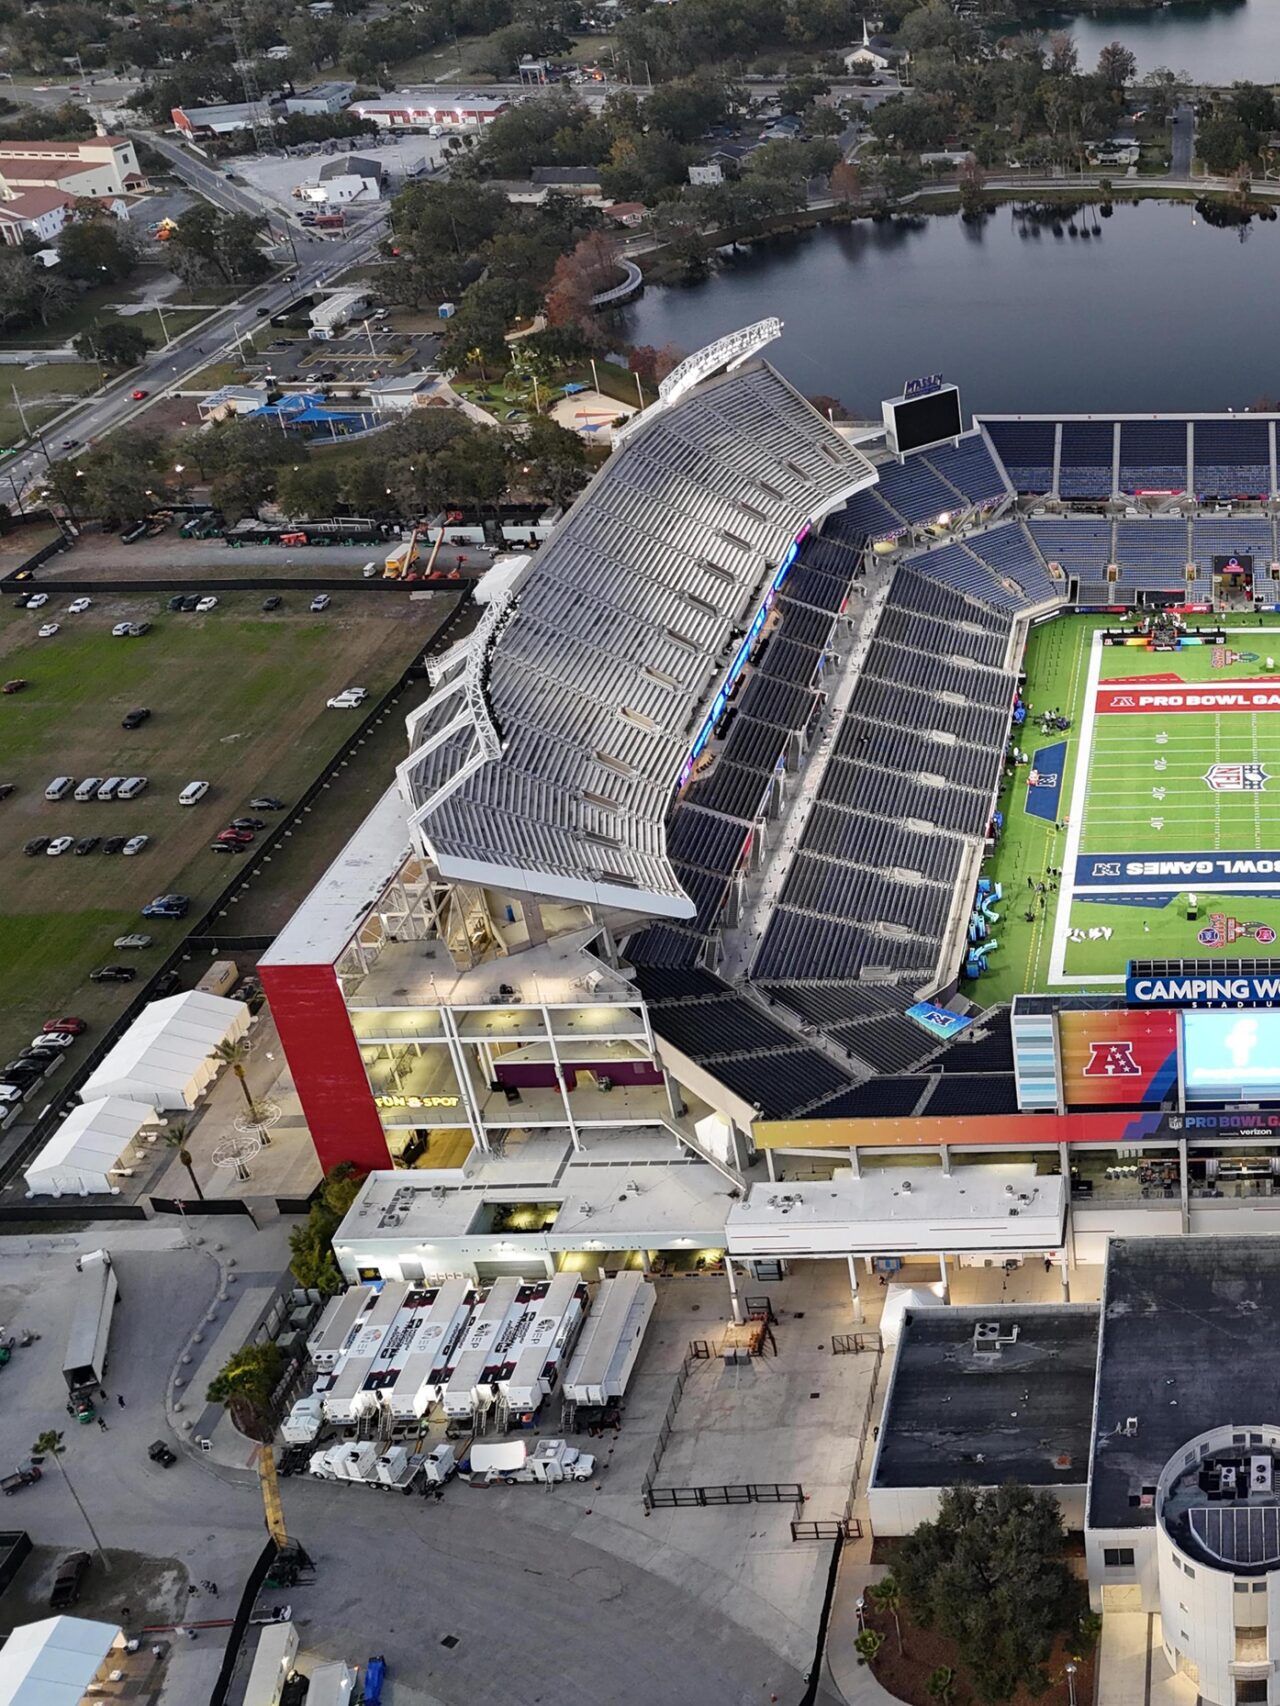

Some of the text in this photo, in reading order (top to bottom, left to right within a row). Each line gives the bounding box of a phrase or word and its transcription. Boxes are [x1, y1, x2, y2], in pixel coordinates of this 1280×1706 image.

[1139, 696, 1184, 706] PRO
[1185, 695, 1250, 706] BOWL
[1212, 766, 1241, 788] NFL
[1126, 861, 1213, 875] GAMES
[1134, 979, 1250, 1000] CAMPING
[1082, 1040, 1142, 1077] A
[375, 1095, 459, 1108] FUN SPOT
[1185, 1116, 1217, 1129] PRO
[1219, 1115, 1266, 1128] BOWL
[1239, 1128, 1273, 1136] verizon
